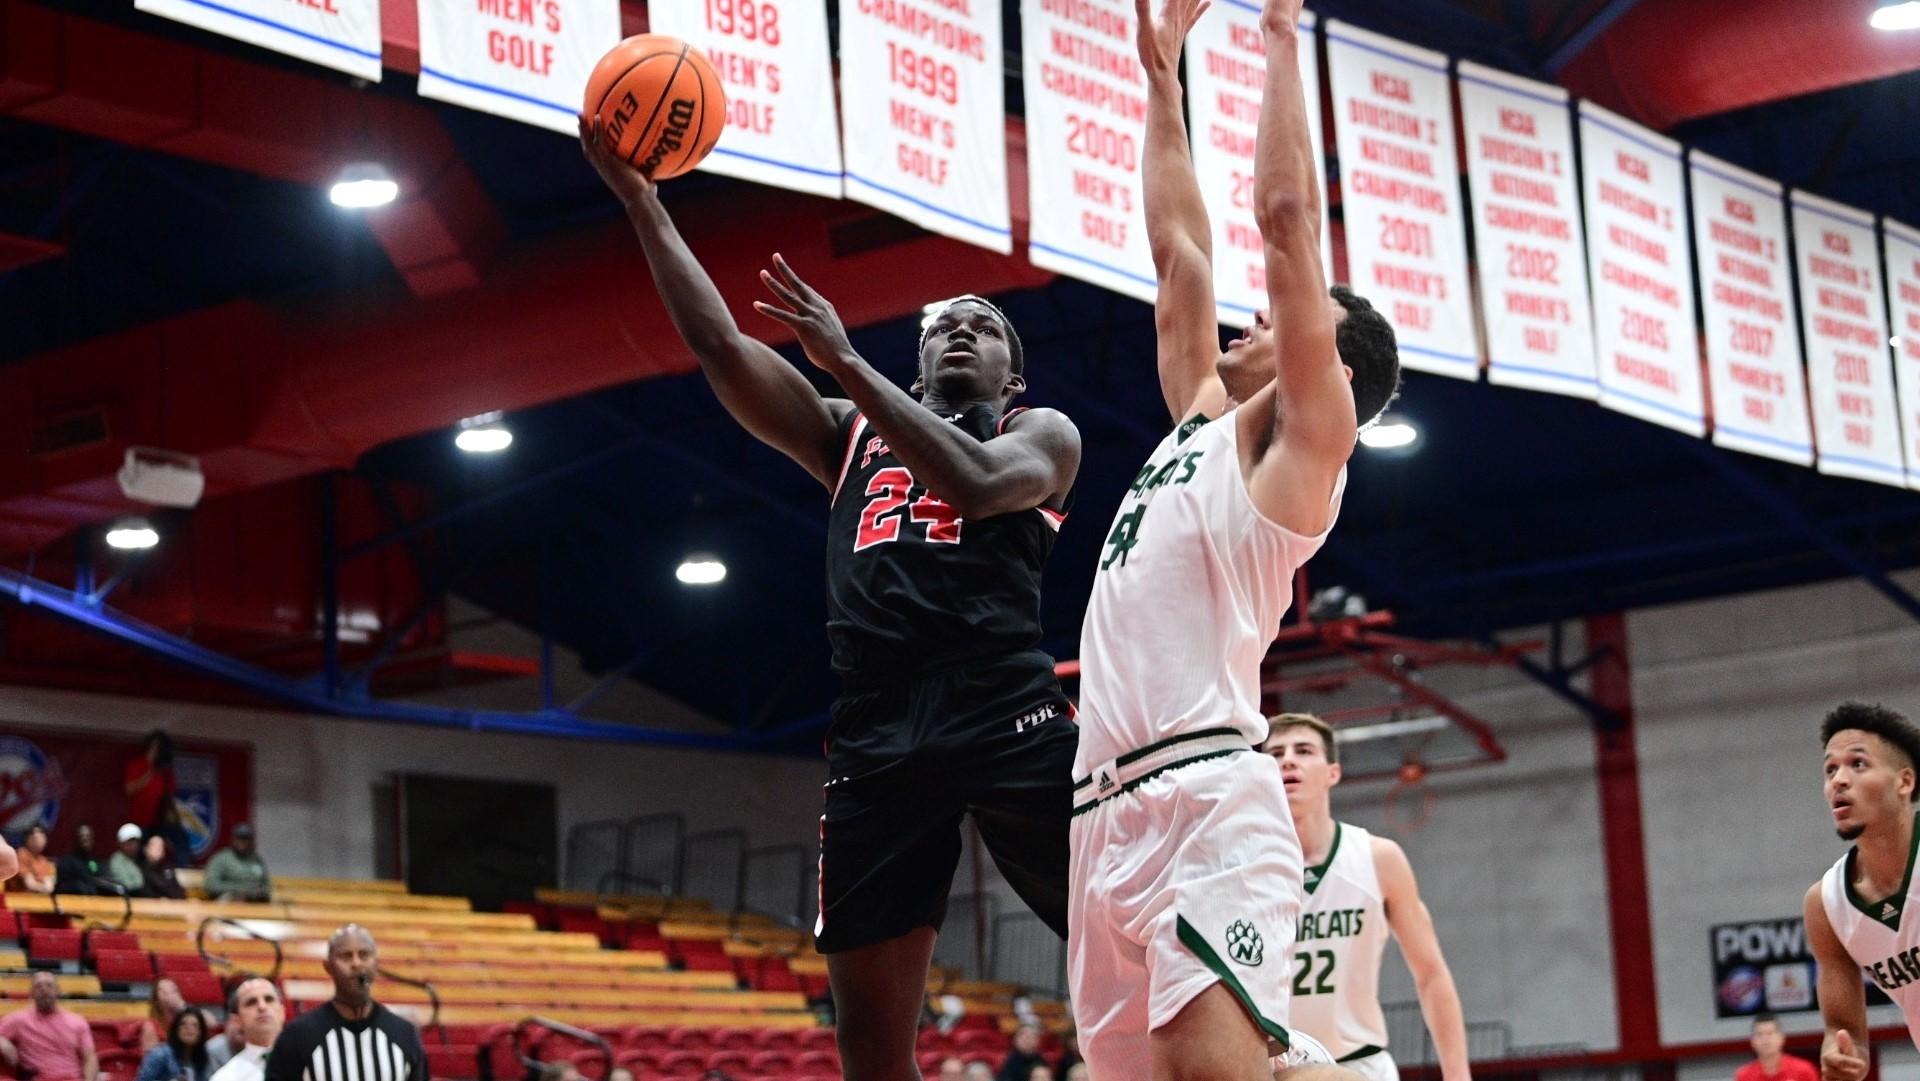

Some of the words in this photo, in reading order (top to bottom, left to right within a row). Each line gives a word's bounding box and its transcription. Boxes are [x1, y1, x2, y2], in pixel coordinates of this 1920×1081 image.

[704, 0, 781, 46] 1998
[1228, 20, 1267, 58] NCA
[488, 29, 555, 77] GOLF
[708, 47, 780, 93] MEN'S
[886, 40, 958, 106] 1999
[1050, 26, 1143, 87] NATIONAL
[1040, 60, 1149, 125] CHAMPION
[1371, 69, 1413, 104] NCAA
[889, 98, 956, 150] MEN'S
[1348, 96, 1422, 140] DIVISION
[1497, 105, 1538, 140] NCAA
[896, 142, 949, 187] GOLF
[1064, 112, 1137, 174] 2000
[1360, 136, 1434, 180] NATIONAL
[1478, 133, 1546, 172] DIVISION
[1073, 169, 1133, 214] MEN'S
[1350, 169, 1449, 216] CHAMPIONS
[1490, 170, 1559, 209] NATIONAL
[1081, 210, 1127, 249] GOLF
[1378, 213, 1434, 260] 2001
[1483, 201, 1574, 243] CHAMPIONS
[1372, 261, 1448, 302] WOMEN'S
[1505, 241, 1561, 288] 2002
[1393, 300, 1432, 332] GOLF
[1504, 289, 1573, 327] WOMEN'S
[1619, 304, 1669, 352] 2005
[1522, 325, 1560, 355] GOLF
[853, 466, 963, 553] 24
[1015, 703, 1060, 734] PBC
[1717, 922, 1813, 963] POW
[1292, 949, 1336, 996] 22
